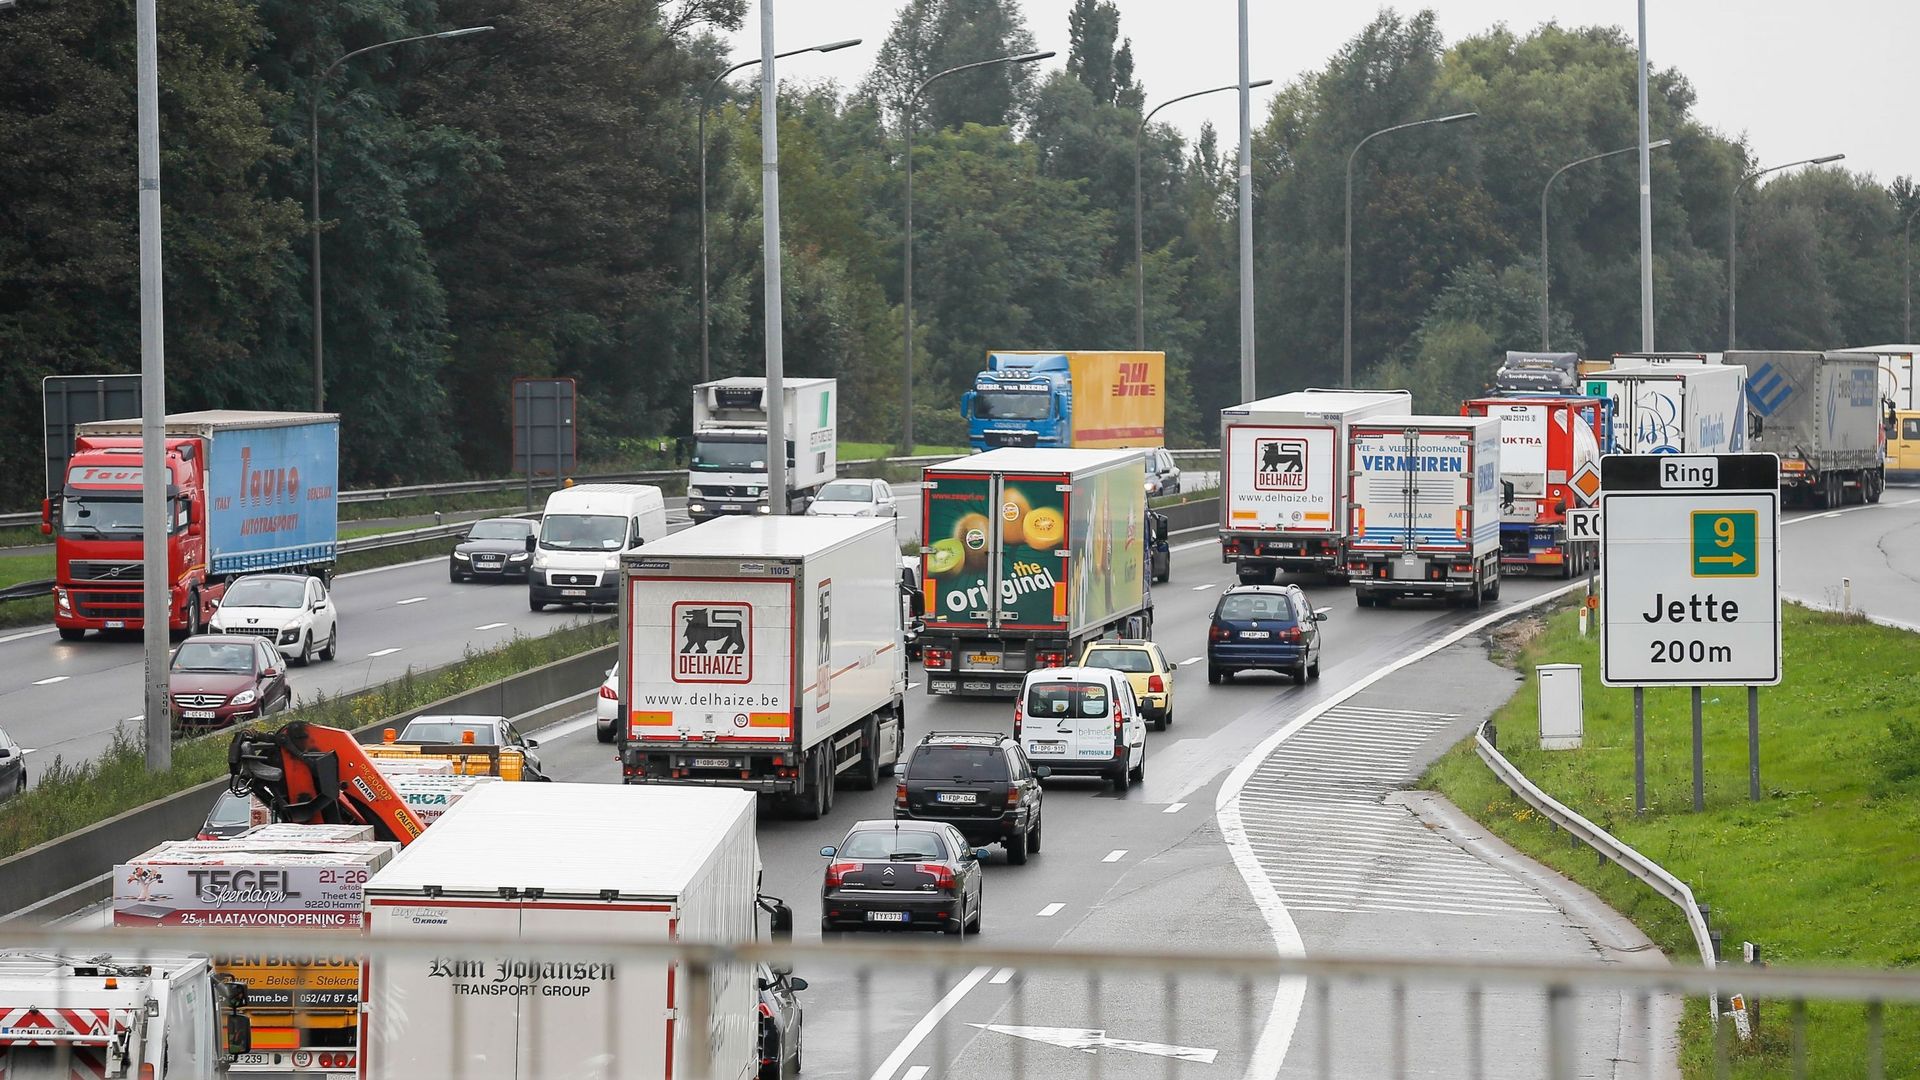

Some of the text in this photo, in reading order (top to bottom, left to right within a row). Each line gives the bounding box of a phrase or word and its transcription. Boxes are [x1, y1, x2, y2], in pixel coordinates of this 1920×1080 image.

[1362, 455, 1462, 473] VERMEIREN
[83, 469, 143, 480] Taur
[240, 446, 299, 507] Tauro
[1259, 473, 1302, 486] DELHAIZE
[1664, 463, 1714, 487] Ring
[1238, 493, 1324, 503] www.delhaize.be
[240, 513, 299, 536] AUTOTRASPORTI
[1714, 517, 1735, 548] 9
[770, 567, 790, 575] 11015
[1013, 561, 1042, 577] the
[946, 567, 1056, 612] original
[1642, 594, 1739, 623] Jette
[1650, 640, 1732, 663] 200m
[679, 655, 743, 675] DELHAIZE
[645, 692, 779, 706] www.delhaize.be
[354, 777, 375, 800] ADAM
[187, 869, 368, 897] TEGEL 21-26
[201, 884, 287, 909] Sfeerdagen
[321, 892, 362, 900] Theet 45
[304, 900, 331, 909] 9220
[391, 906, 414, 918] Dry
[208, 913, 346, 925] LAATAVONDOPENING
[428, 956, 617, 984] Kim Johansen
[266, 975, 305, 986] Belsele
[316, 975, 359, 986] Stekene
[333, 993, 345, 1003] 87
[346, 993, 359, 1003] 54
[452, 983, 591, 997] TRANSPORT GROUP
[296, 1052, 308, 1061] 60
